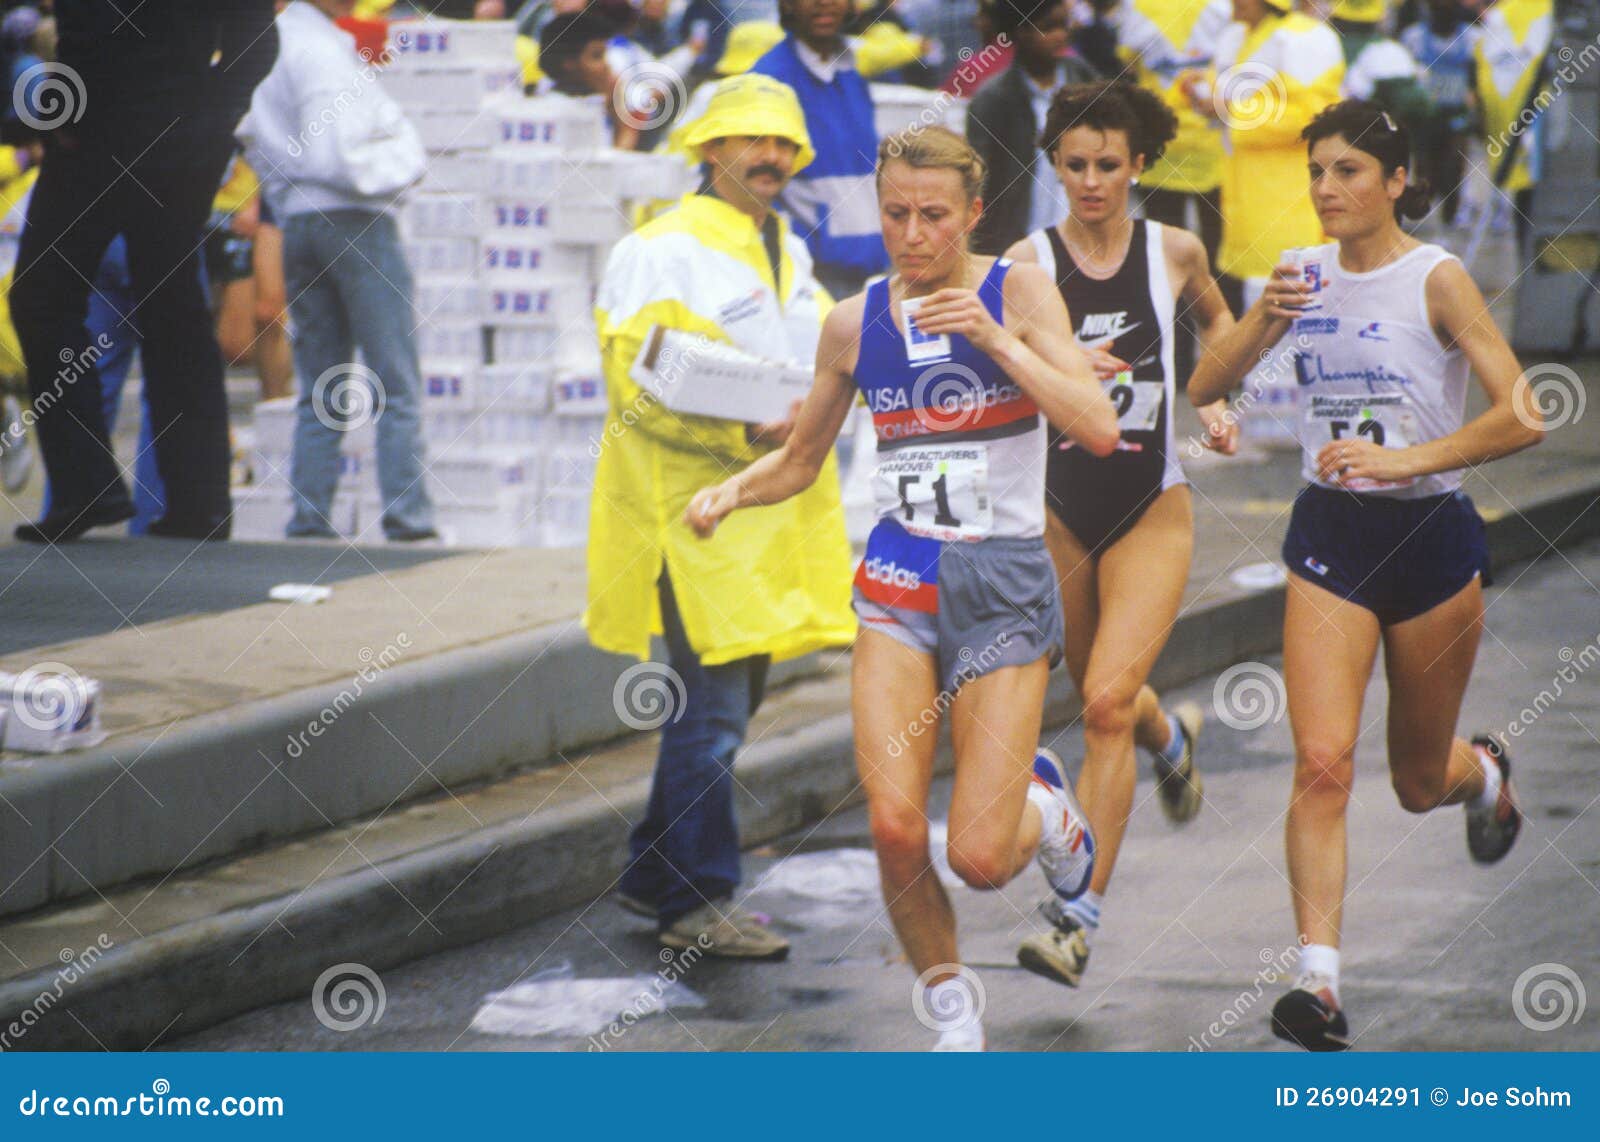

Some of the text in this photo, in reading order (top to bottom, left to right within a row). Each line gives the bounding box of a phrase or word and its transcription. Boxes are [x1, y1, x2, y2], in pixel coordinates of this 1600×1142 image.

[1080, 311, 1128, 336] NIKE
[867, 387, 909, 412] USA
[943, 383, 1024, 413] adidas
[864, 556, 921, 590] adidas
